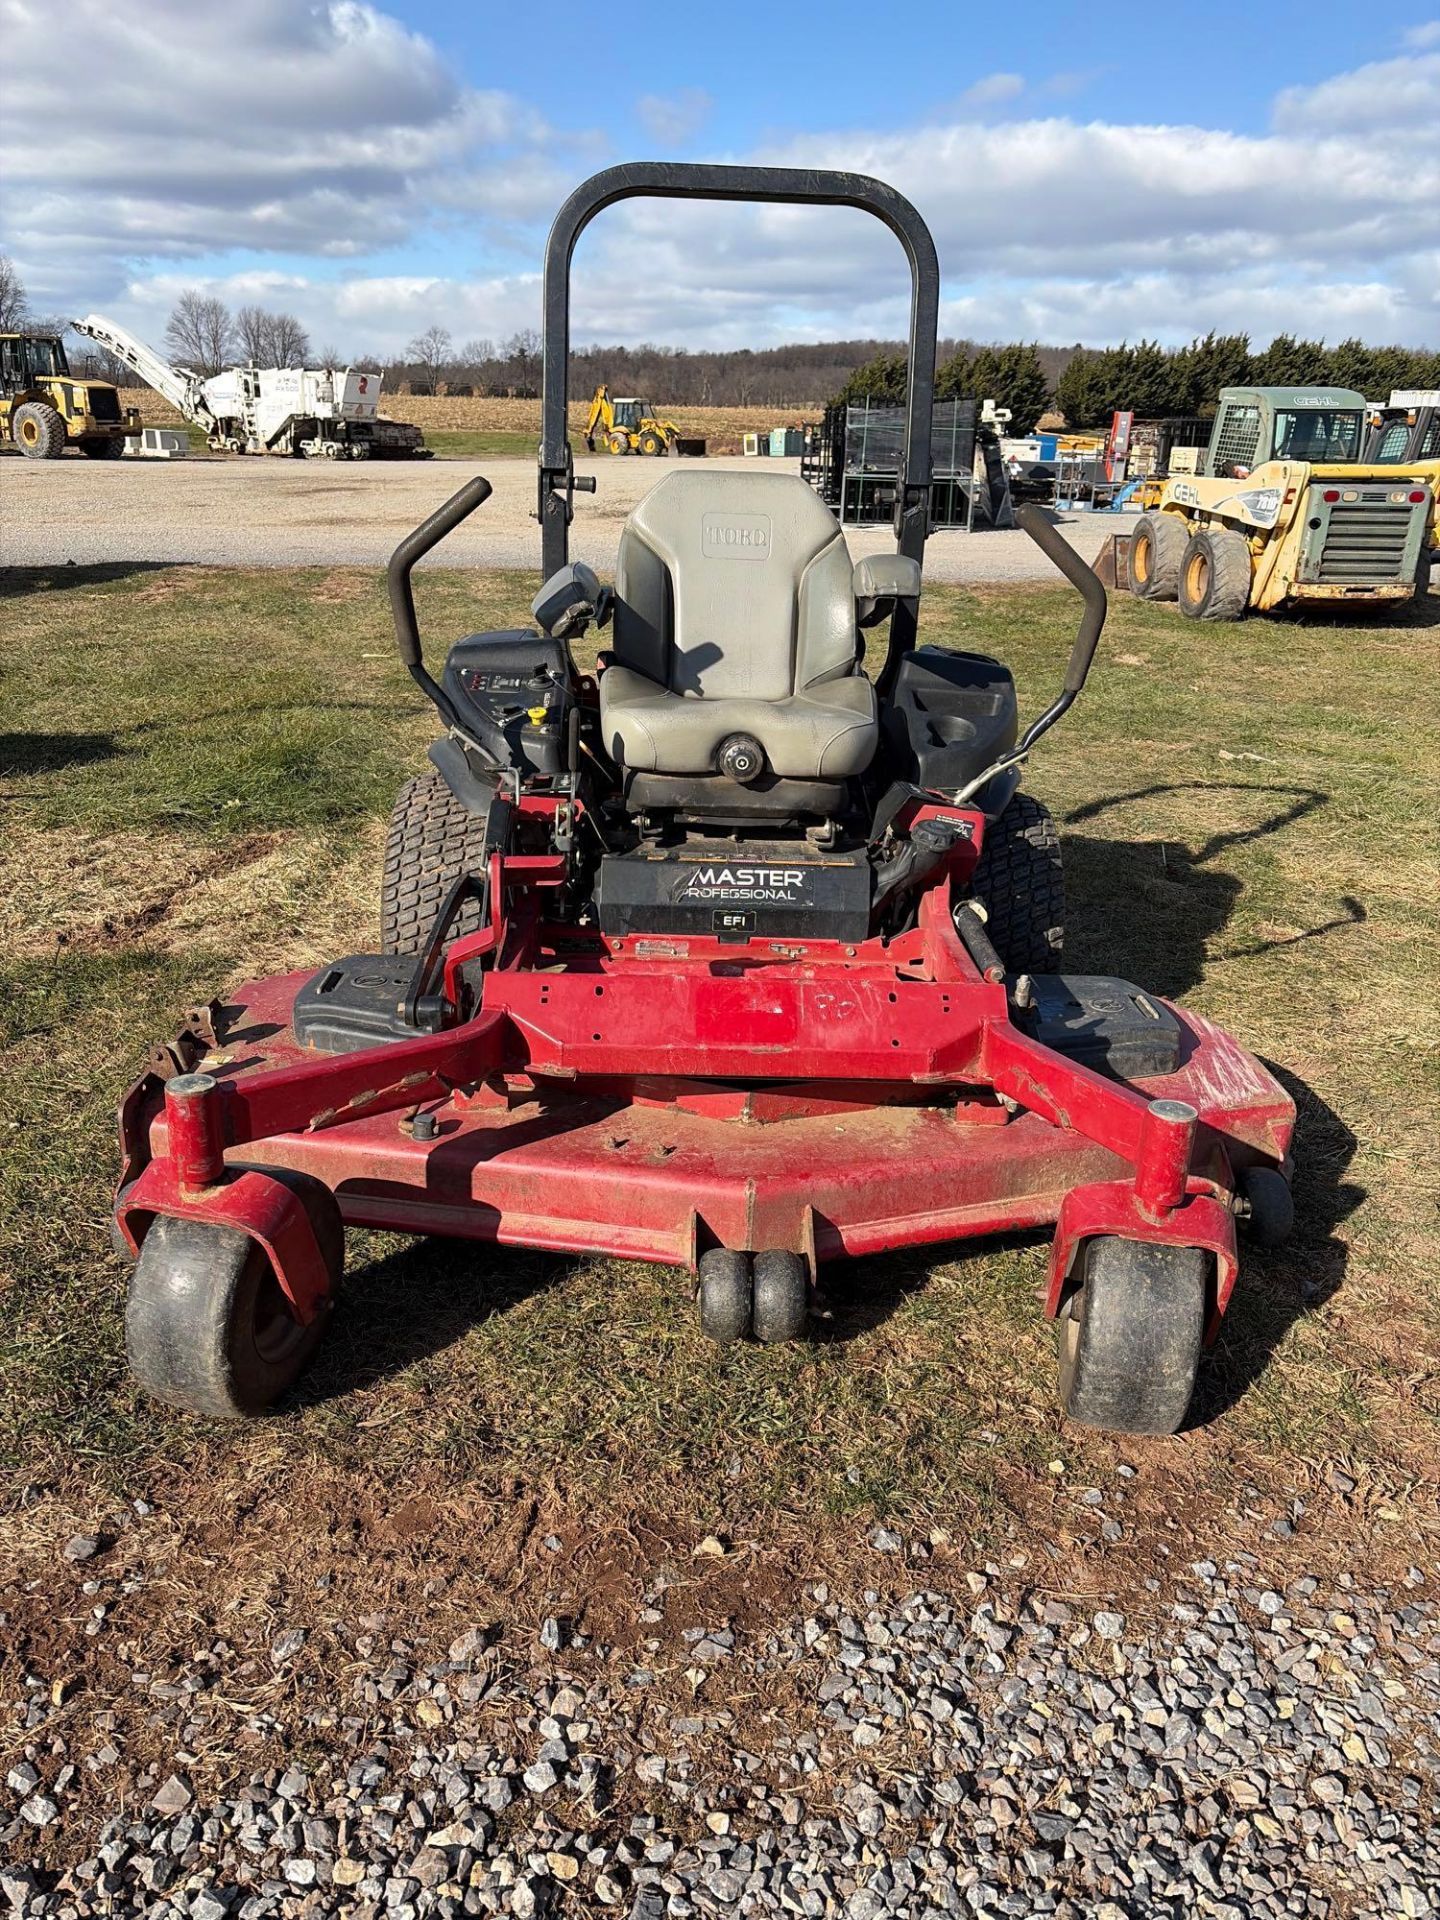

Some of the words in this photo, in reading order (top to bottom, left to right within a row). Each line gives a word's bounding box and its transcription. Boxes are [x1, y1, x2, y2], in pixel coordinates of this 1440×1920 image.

[1294, 396, 1340, 406] GEHL
[1174, 483, 1201, 505] GEHL
[687, 868, 803, 887] MASTER
[723, 916, 746, 927] EFI
